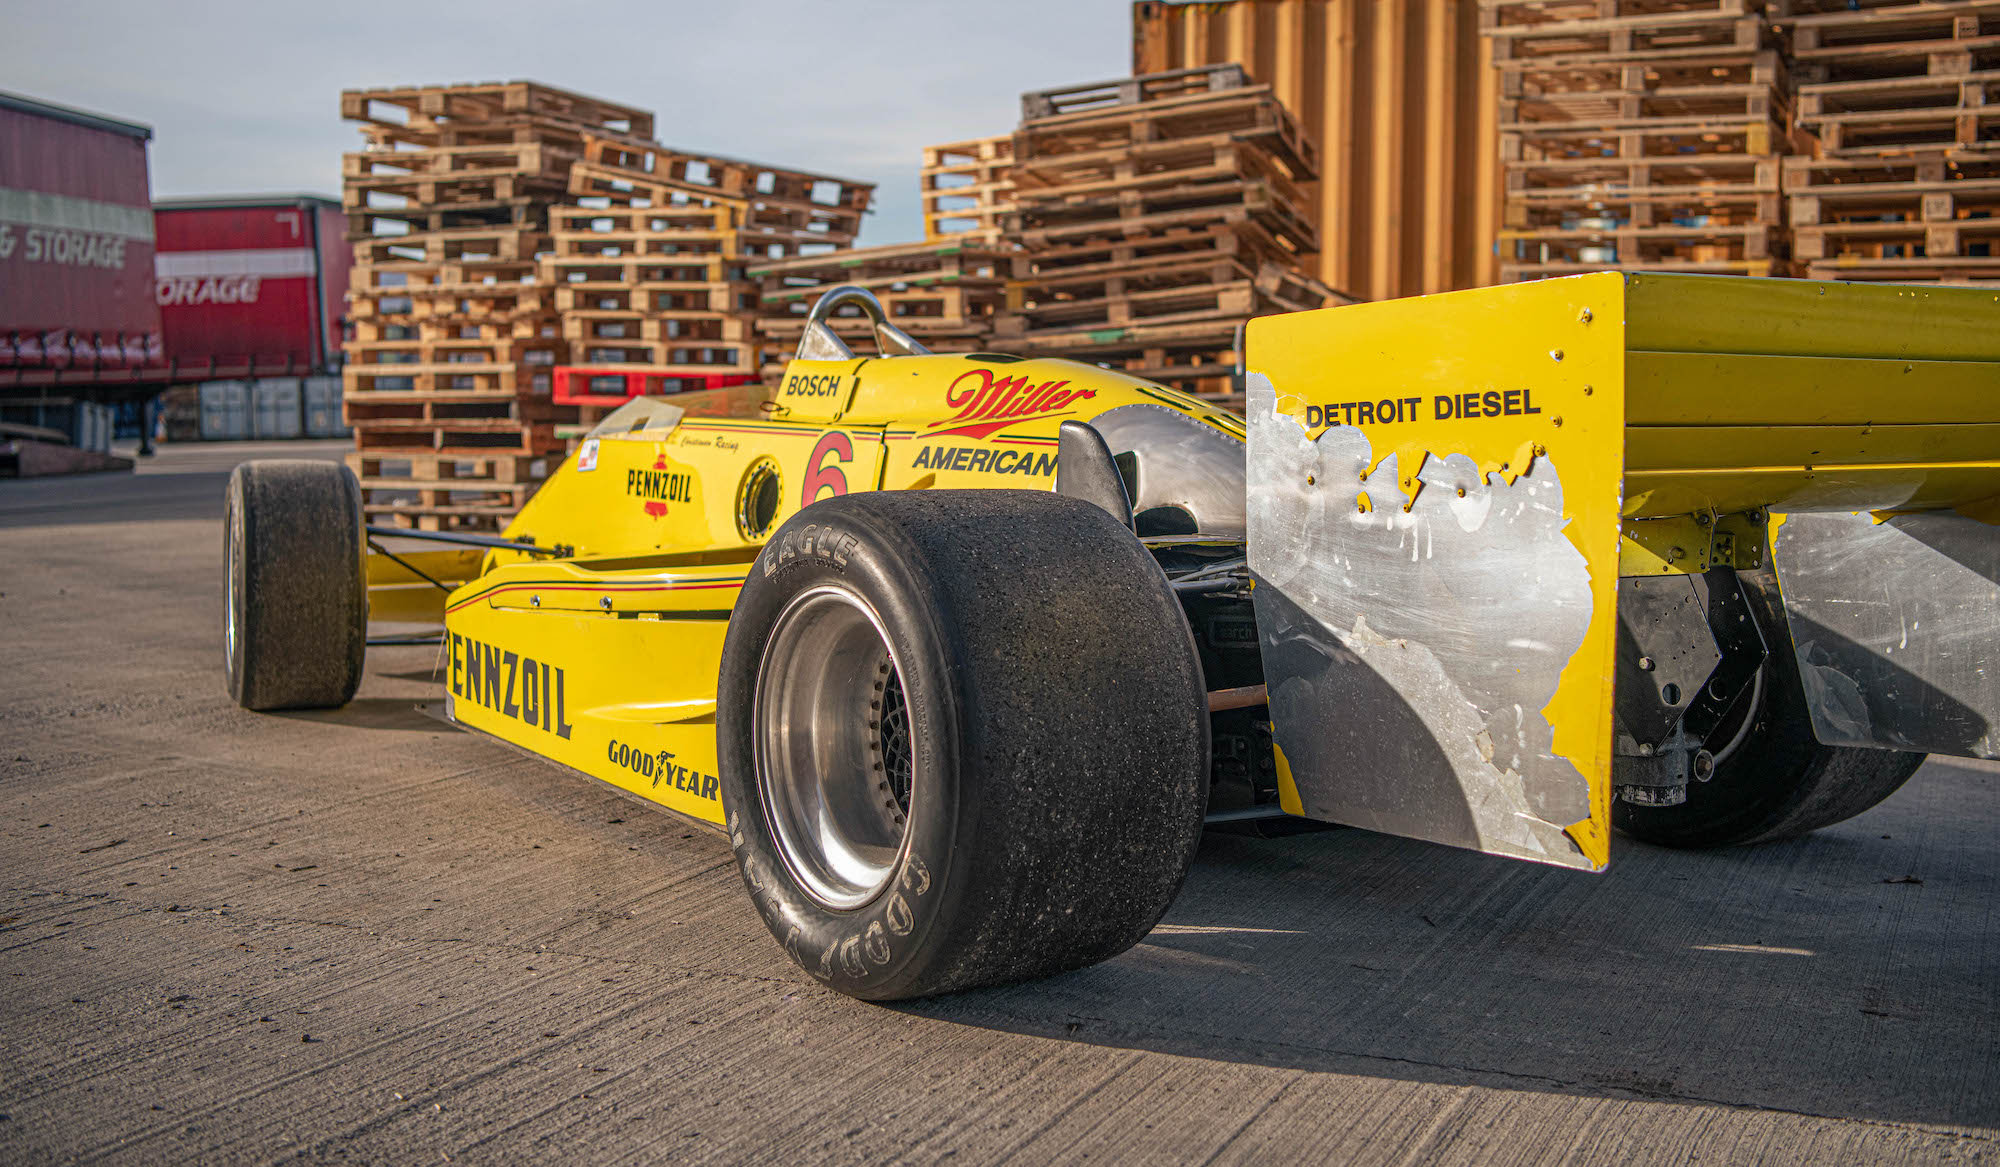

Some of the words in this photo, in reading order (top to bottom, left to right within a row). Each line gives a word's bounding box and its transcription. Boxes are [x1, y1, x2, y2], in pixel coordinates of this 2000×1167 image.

[25, 230, 126, 268] STORAGE
[786, 375, 841, 397] BOSCH
[927, 369, 1098, 428] Miller
[1306, 397, 1421, 428] DETROIT
[1434, 389, 1541, 420] DIESEL
[801, 431, 852, 510] 6
[912, 446, 1058, 477] AMERICAN
[627, 468, 692, 503] PENNZOIL
[765, 523, 859, 577] EAGLE
[608, 739, 719, 802] GOODYEAR
